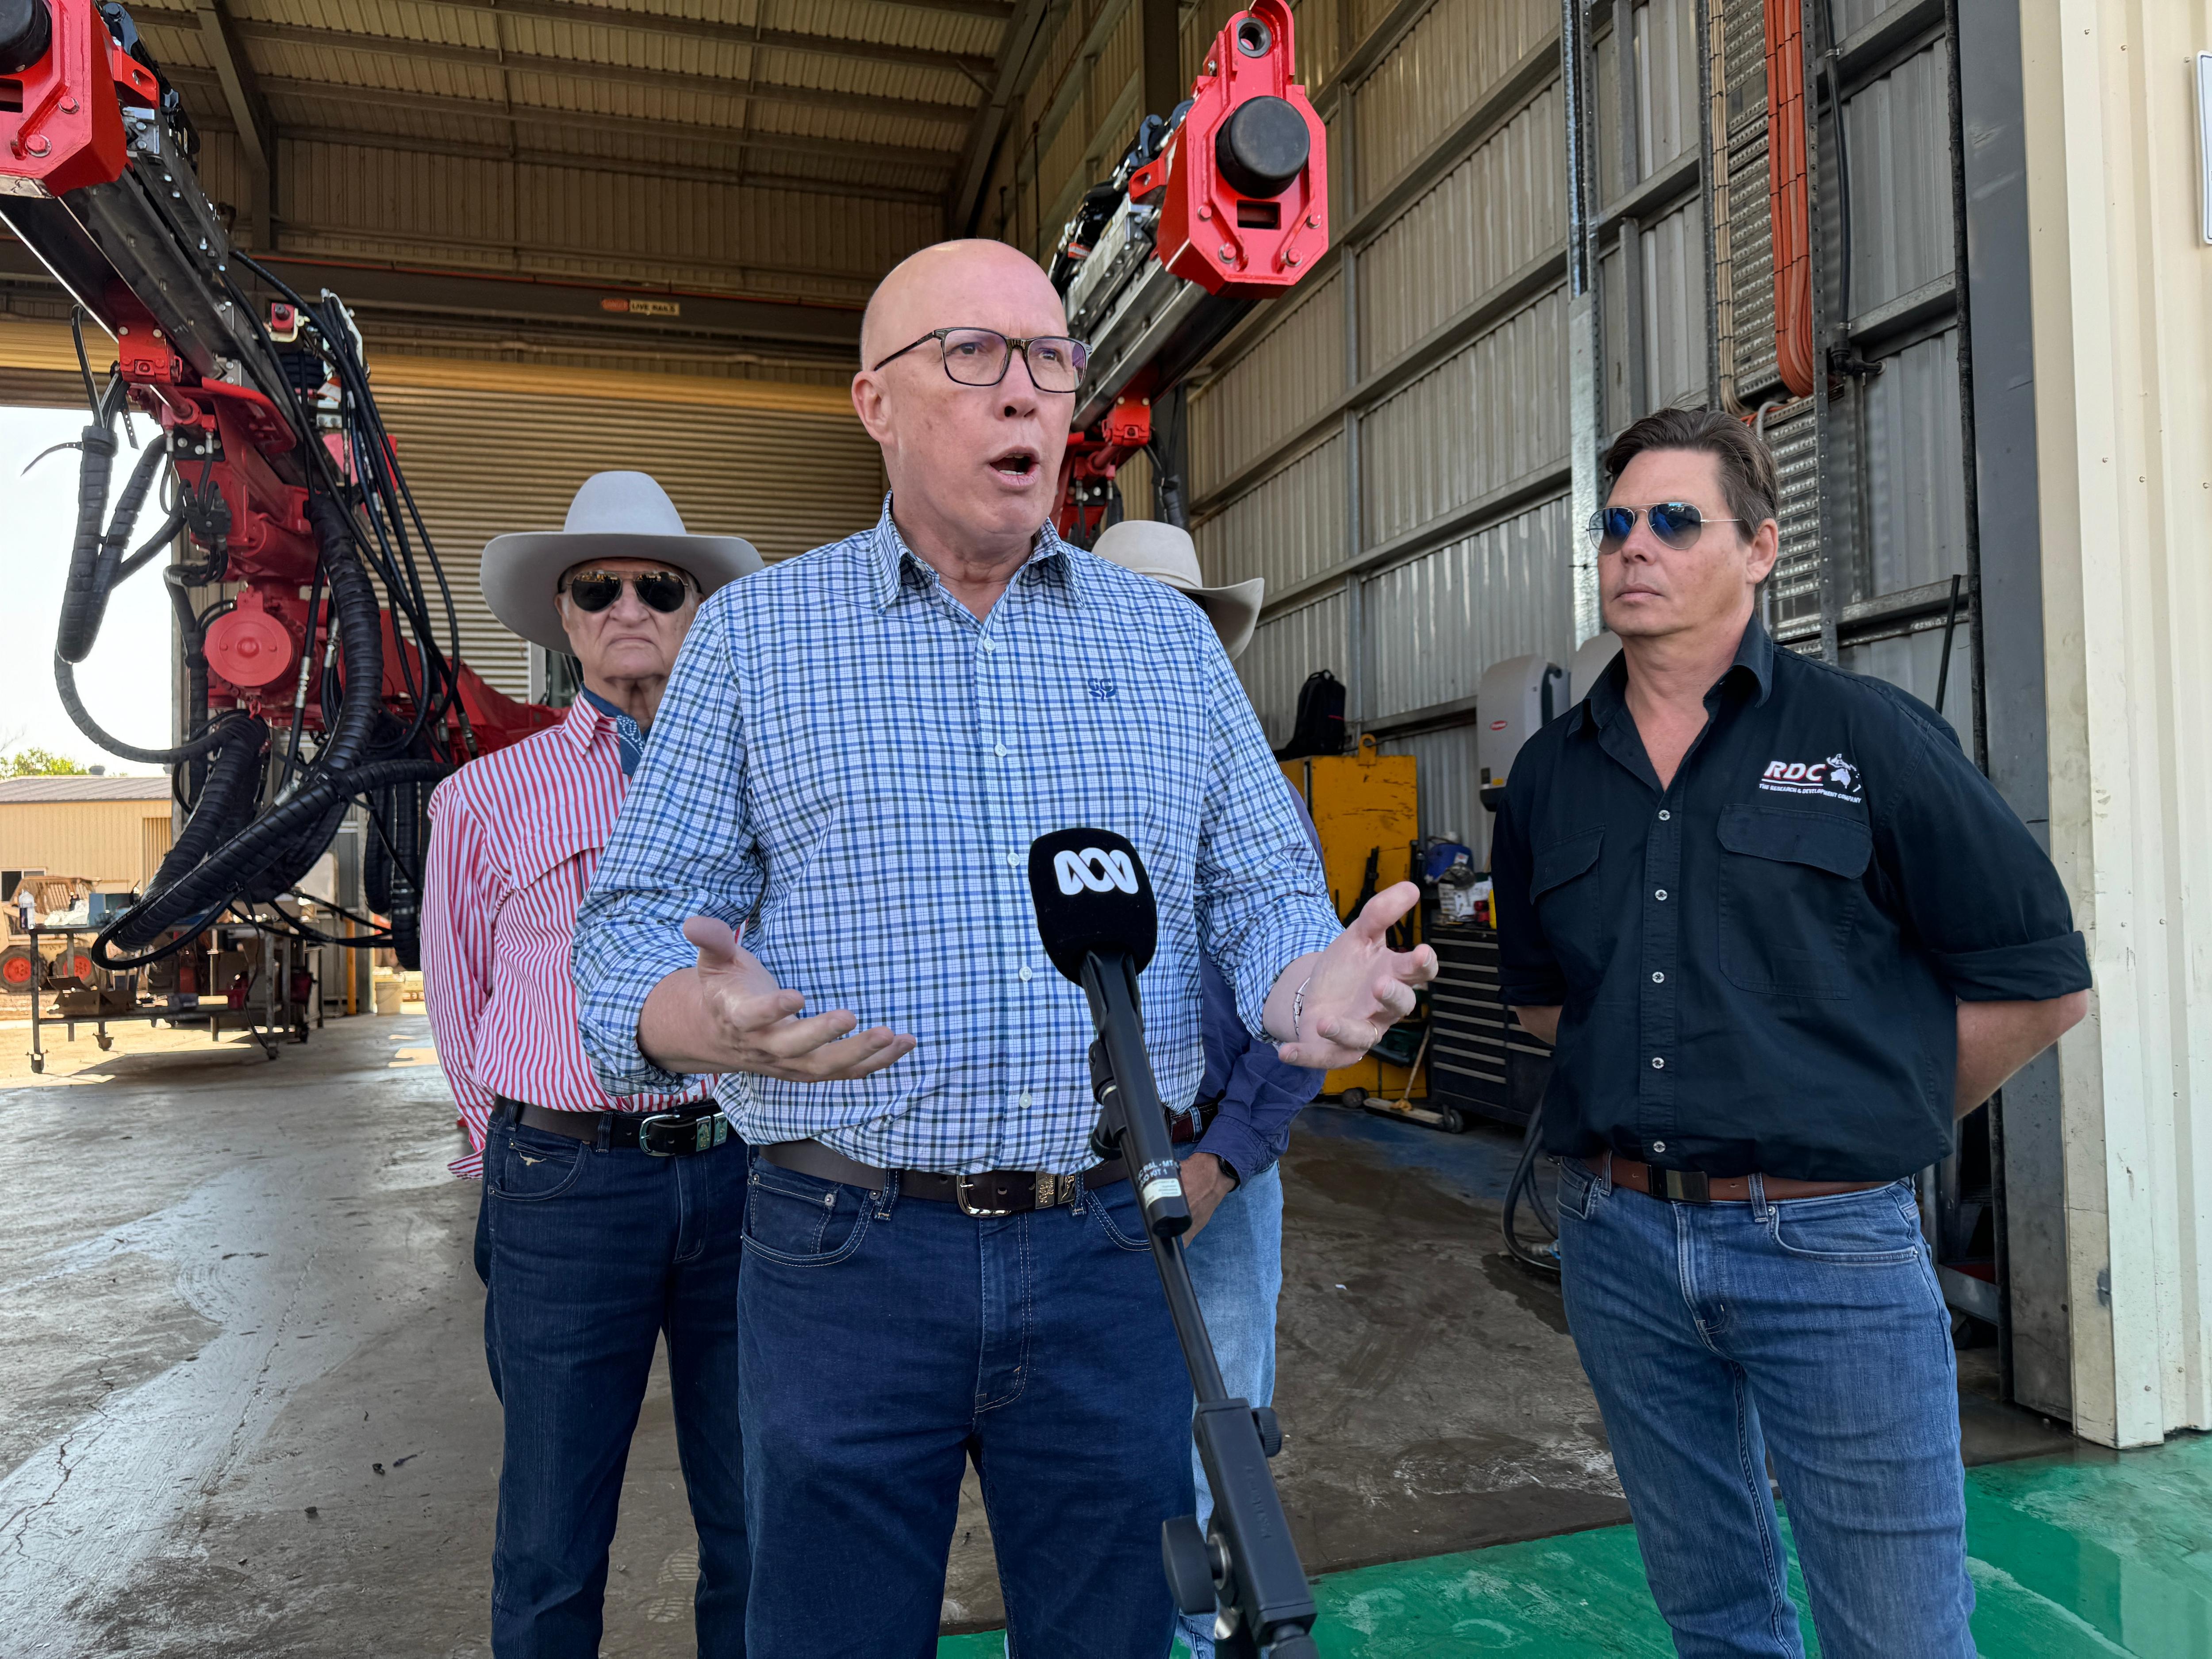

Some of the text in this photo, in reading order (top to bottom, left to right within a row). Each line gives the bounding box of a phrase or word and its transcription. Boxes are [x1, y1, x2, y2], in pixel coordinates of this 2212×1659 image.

[1763, 760, 1828, 782] RDC
[1802, 788, 1838, 798] DEVELOPMENT
[1838, 793, 1862, 803] COMPANY
